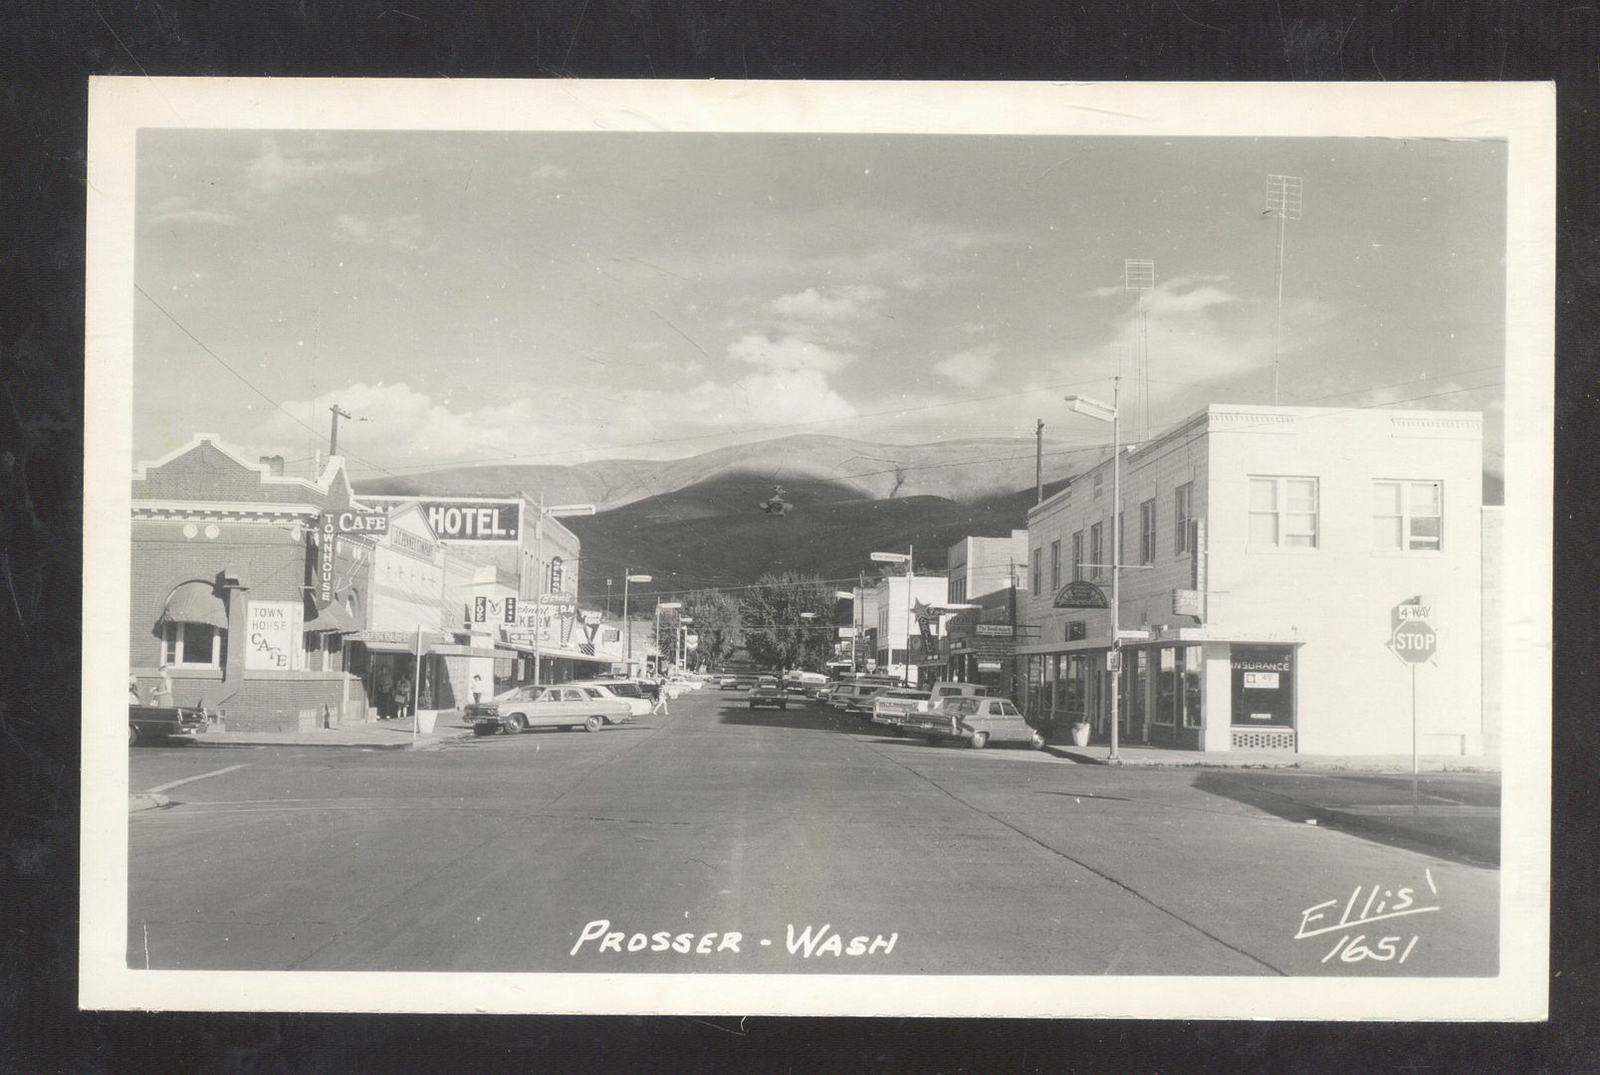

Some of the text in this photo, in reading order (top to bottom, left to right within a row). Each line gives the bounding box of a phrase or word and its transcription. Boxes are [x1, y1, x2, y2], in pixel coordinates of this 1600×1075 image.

[338, 512, 387, 532] CAFE
[321, 513, 335, 602] TOWNHOUSE
[253, 607, 284, 618] TOWN
[1401, 605, 1432, 619] 4-WAY
[250, 632, 288, 668] CAFE
[1396, 632, 1436, 651] STOP
[1230, 661, 1290, 671] INSURANCE
